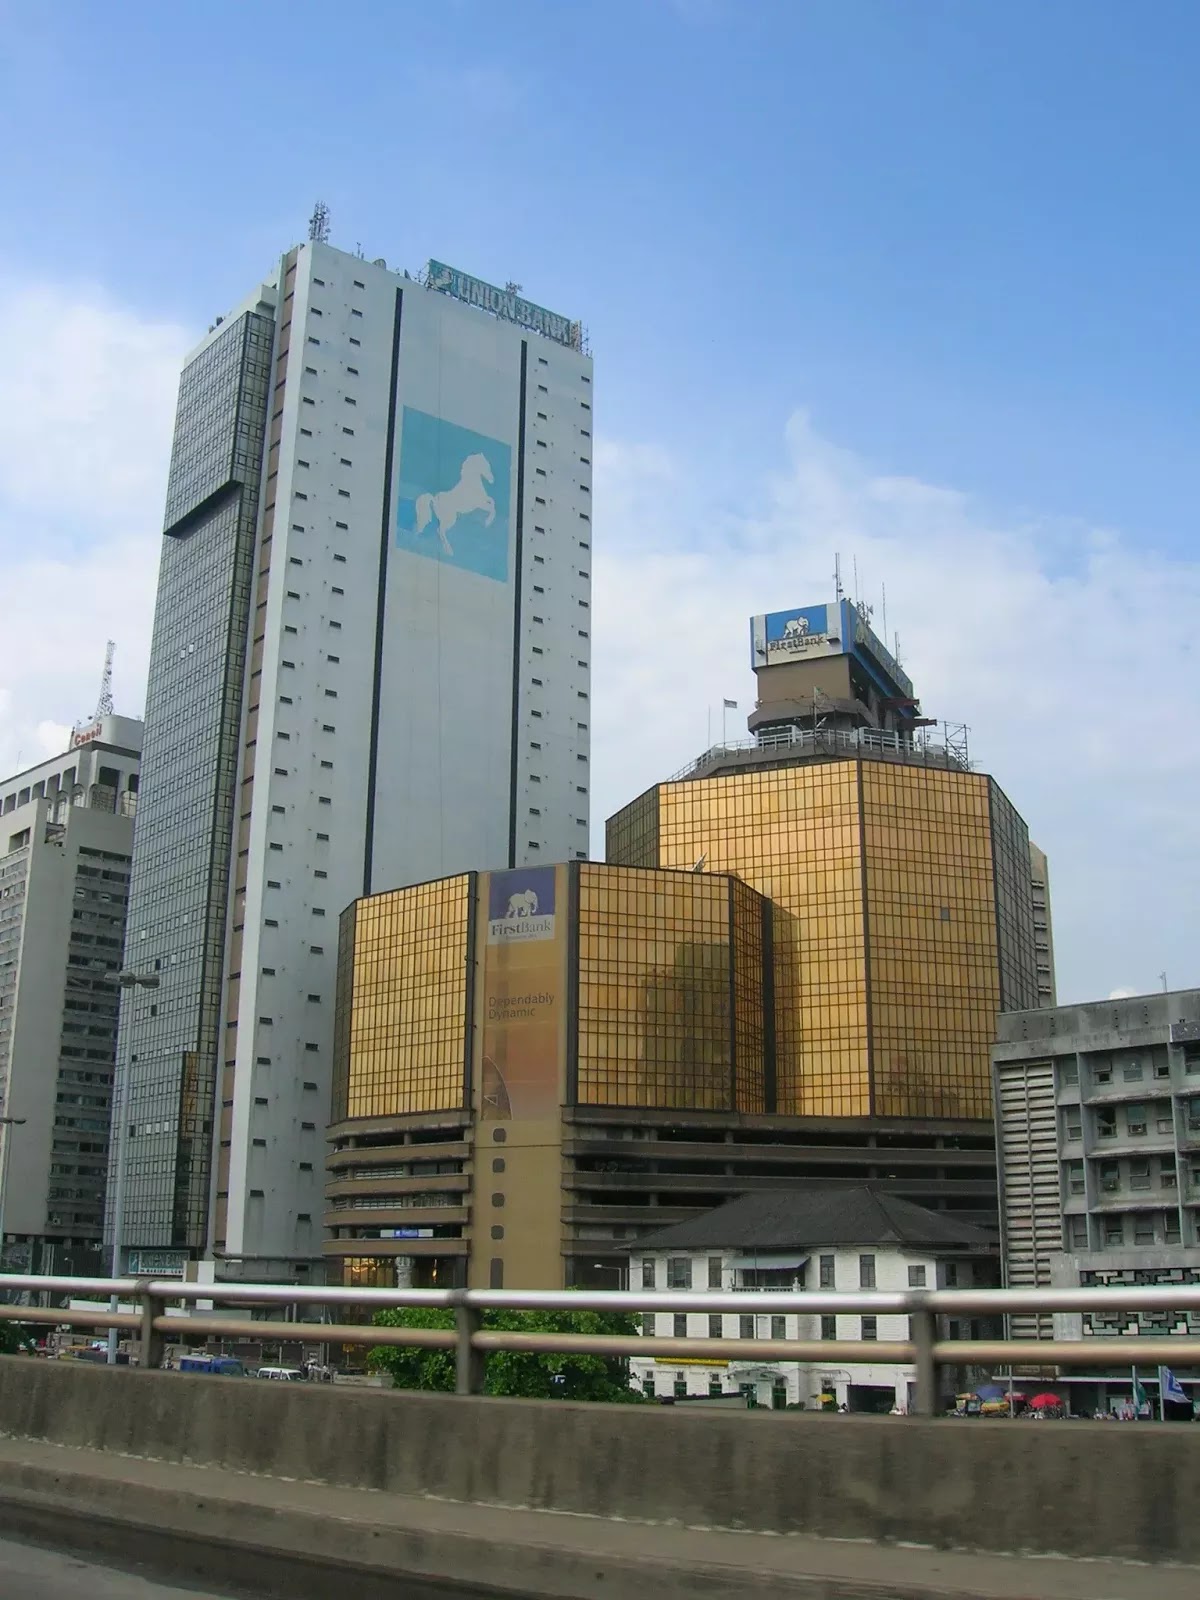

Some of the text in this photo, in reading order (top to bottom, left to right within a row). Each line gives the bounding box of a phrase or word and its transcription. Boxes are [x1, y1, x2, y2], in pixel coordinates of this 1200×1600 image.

[459, 275, 570, 343] UNION BANK
[769, 635, 824, 651] FirstBank
[492, 920, 551, 936] FirstBank
[489, 992, 554, 1007] Dependably
[488, 1006, 536, 1021] Dynamic
